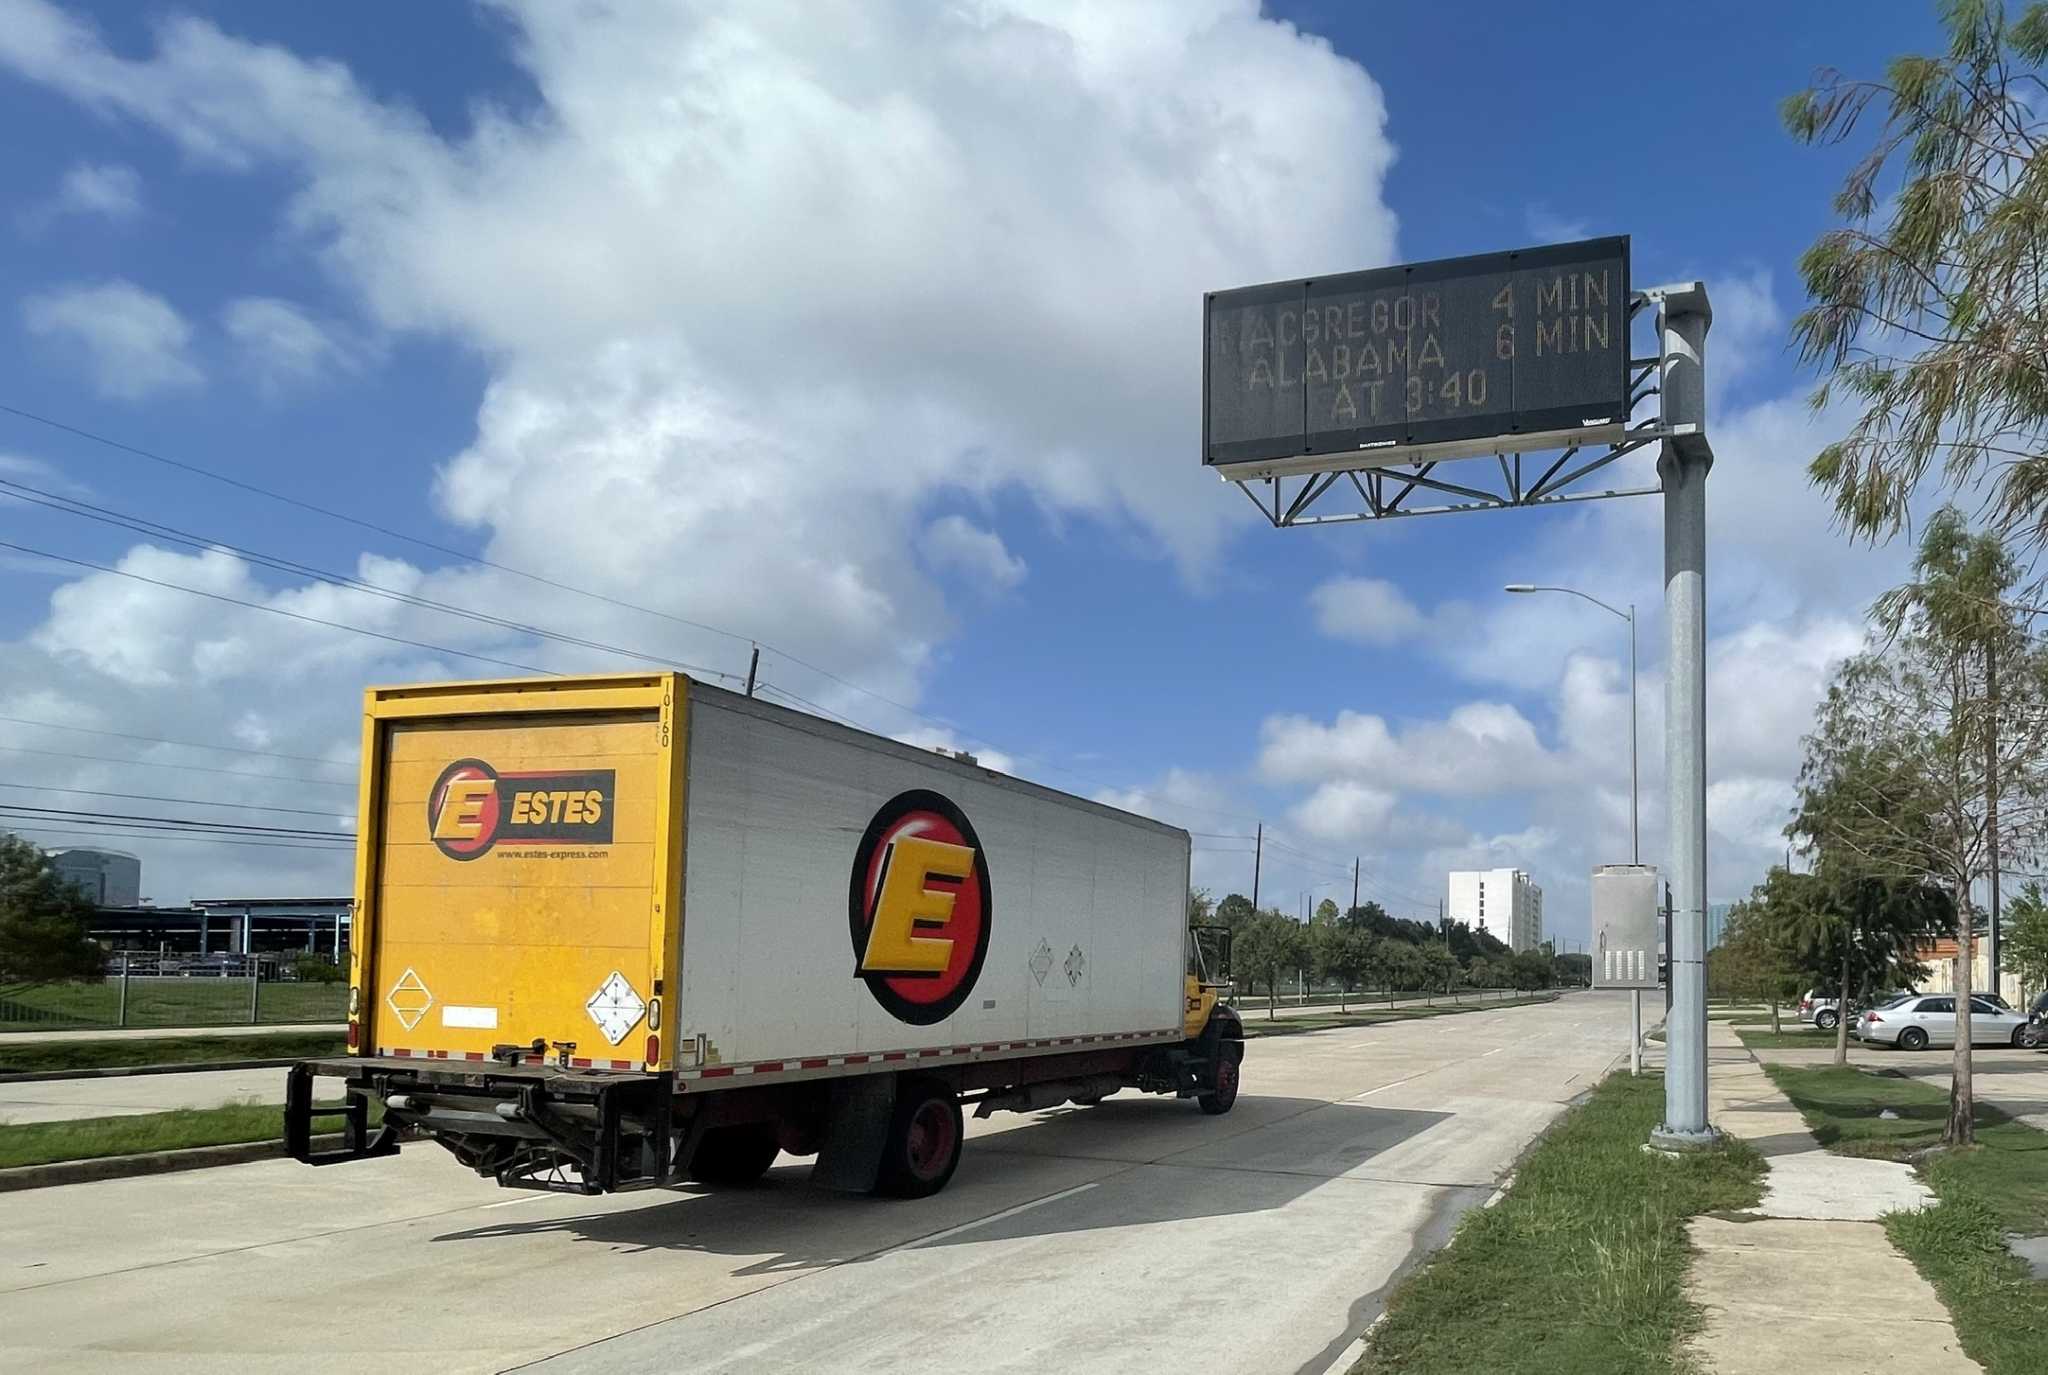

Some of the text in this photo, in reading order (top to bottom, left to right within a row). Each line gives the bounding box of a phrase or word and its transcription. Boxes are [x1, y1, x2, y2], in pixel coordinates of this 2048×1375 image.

[1490, 282, 1513, 318] 4
[1536, 269, 1608, 315] MIN
[1249, 332, 1444, 390] ALABAMA
[1536, 312, 1608, 357] MIN
[1332, 380, 1384, 419] AT
[431, 778, 496, 840] E
[510, 790, 603, 825] ESTES
[497, 850, 609, 860] www.estes-express.com
[854, 834, 976, 978] E
